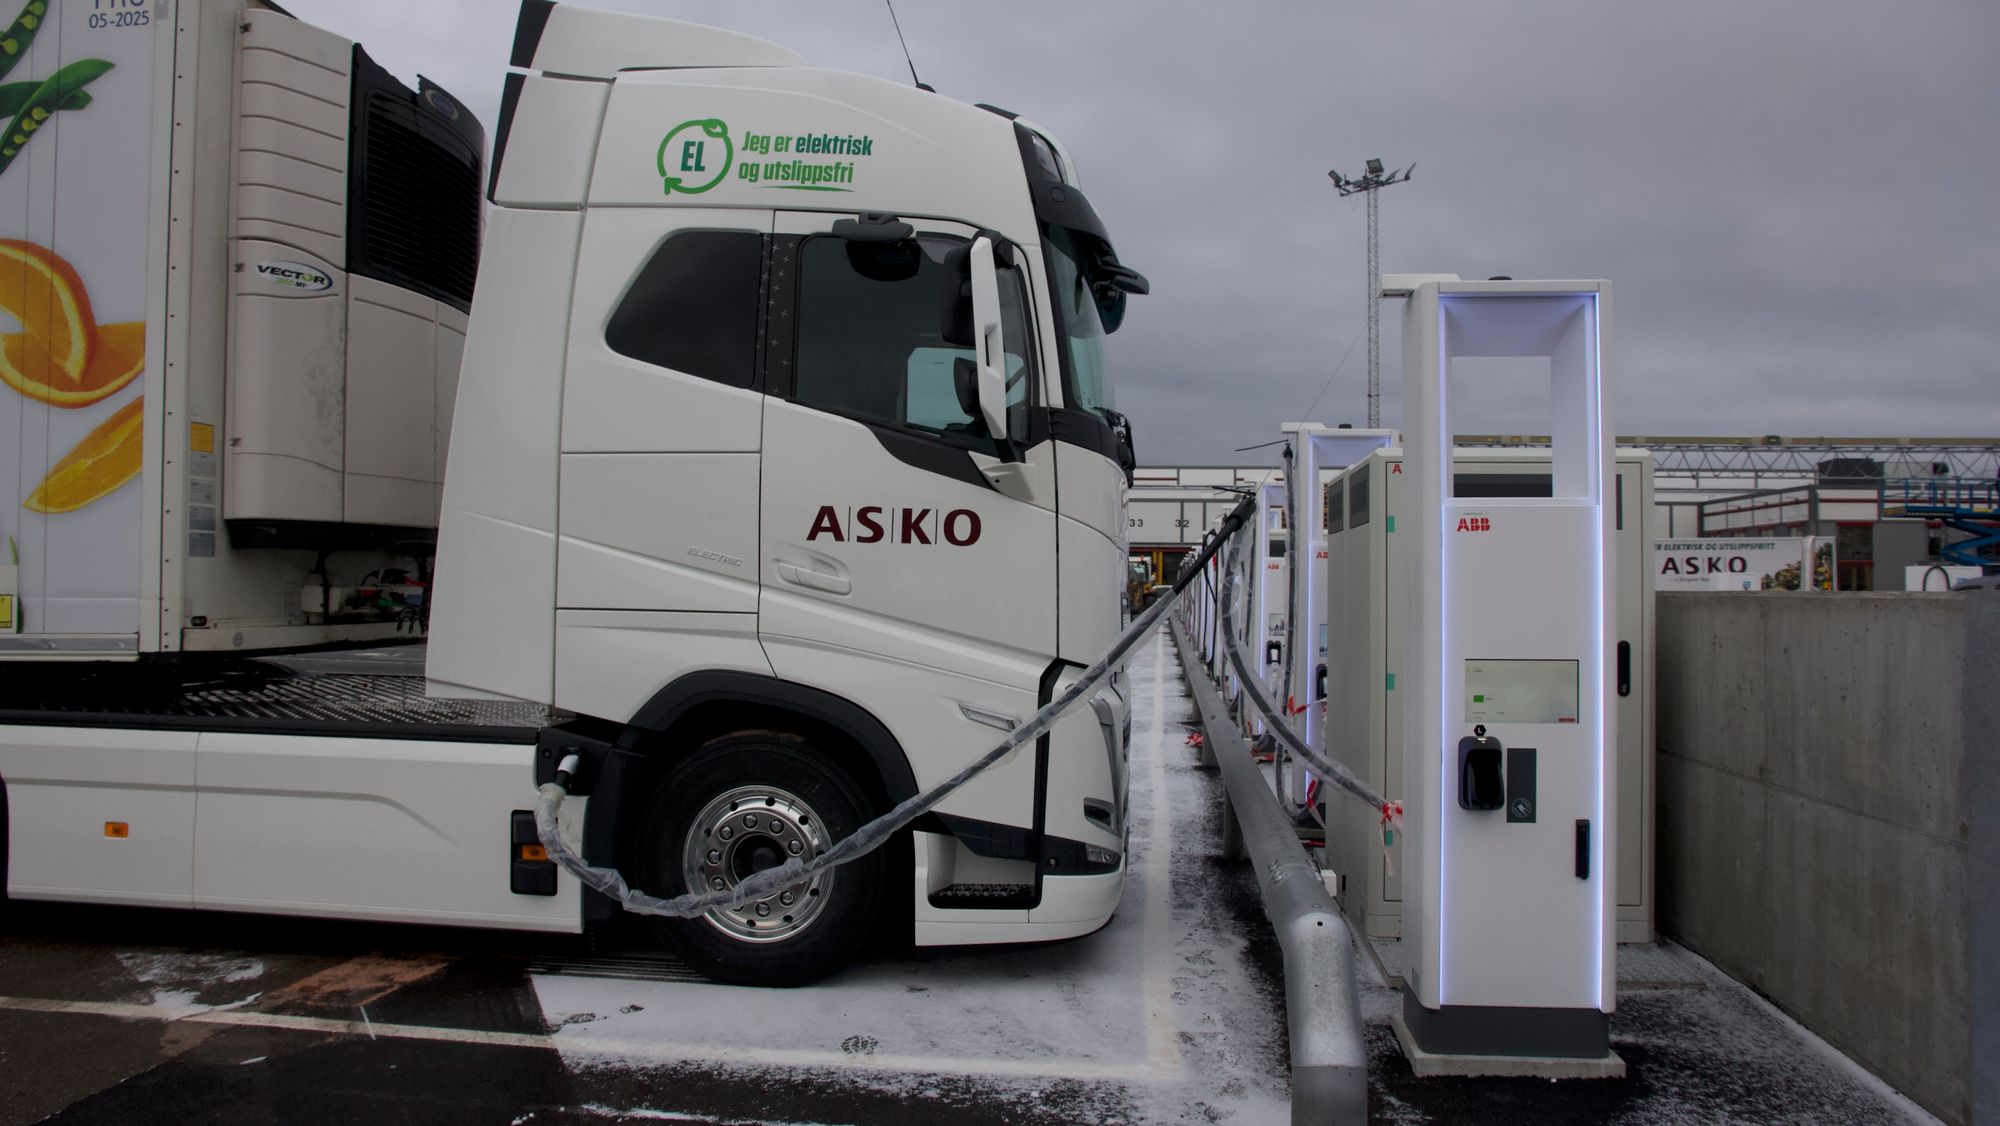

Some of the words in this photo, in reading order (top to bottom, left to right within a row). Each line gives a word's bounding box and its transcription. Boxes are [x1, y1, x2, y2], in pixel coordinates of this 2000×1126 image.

[89, 10, 149, 28] 05-2025
[742, 131, 771, 155] Jeg
[774, 136, 792, 152] er
[795, 133, 873, 156] elektrisk
[680, 141, 706, 172] EL
[738, 164, 760, 183] og
[763, 160, 854, 184] utslippsfri
[257, 265, 325, 284] VECTOR
[806, 505, 982, 546] ASKO
[1129, 518, 1144, 528] 33
[1175, 519, 1190, 528] 32
[1457, 517, 1490, 531] ABB
[1664, 543, 1702, 551] ELEKTRISK
[1661, 556, 1748, 575] ASKO
